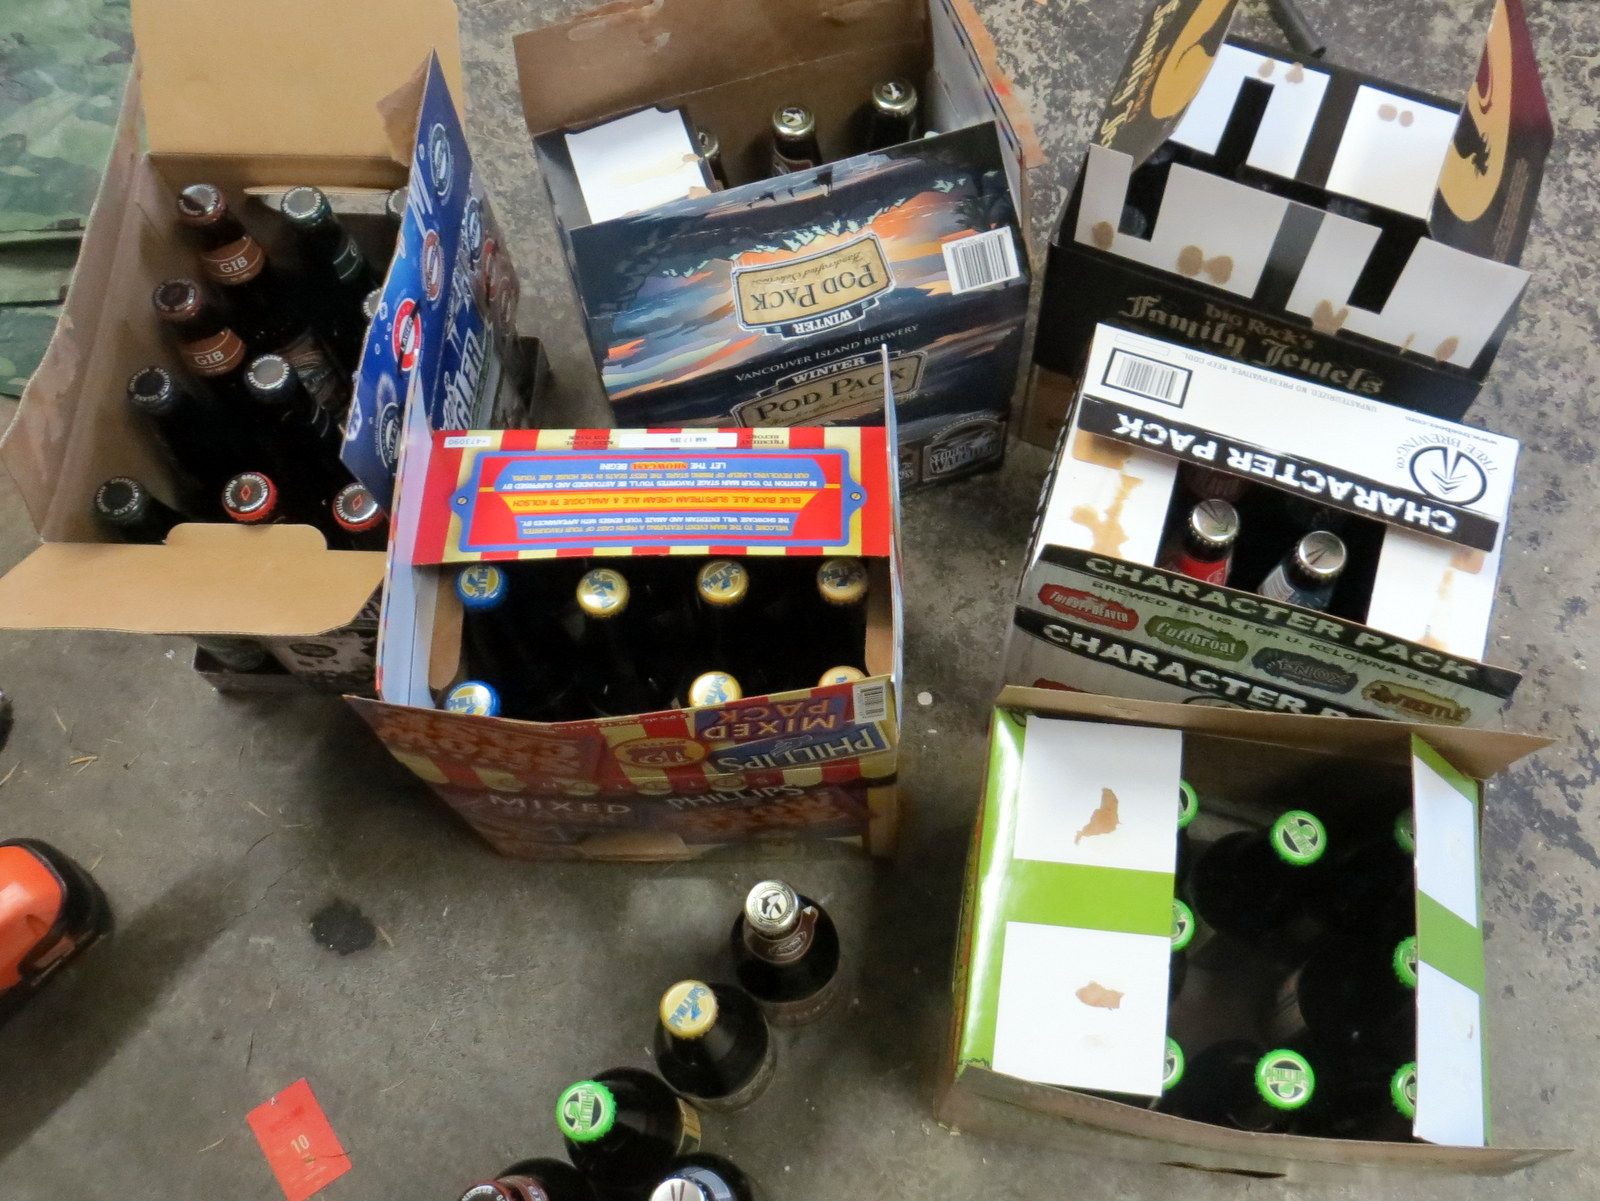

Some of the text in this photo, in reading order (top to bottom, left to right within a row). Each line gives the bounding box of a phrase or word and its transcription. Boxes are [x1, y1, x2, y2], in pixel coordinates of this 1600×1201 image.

[220, 257, 248, 273] GIB
[750, 262, 878, 311] POD PACK
[792, 309, 853, 333] WINTER
[1118, 295, 1245, 360] Family
[195, 350, 224, 367] GIB
[735, 324, 920, 383] VANCOUVER ISLAND BREWERY
[792, 357, 866, 385] WINTER
[756, 391, 821, 422] POD
[1396, 433, 1461, 457] BREWING
[690, 462, 706, 470] THE
[710, 462, 726, 470] LET
[1466, 444, 1498, 475] TREE
[572, 480, 615, 488] ASTOUNDED
[1112, 413, 1458, 534] CHARACTER PACK
[513, 499, 547, 507] KOLSCH
[563, 497, 609, 505] ANALOGUE
[643, 496, 673, 504] CREAM
[676, 496, 729, 504] SLIPSTREAM
[1086, 558, 1477, 680] CHARACTER PACK
[1176, 606, 1204, 617] BY
[1243, 623, 1280, 639] FOR
[1162, 621, 1242, 655] Cutthroat
[1042, 624, 1308, 713] CHARACTER
[717, 699, 829, 720] PACK
[702, 713, 836, 739] MIXED
[717, 726, 877, 773] PHILLIPS
[489, 794, 631, 814] MIXED
[667, 785, 806, 810] PHILLIPS
[291, 1134, 309, 1153] 10
